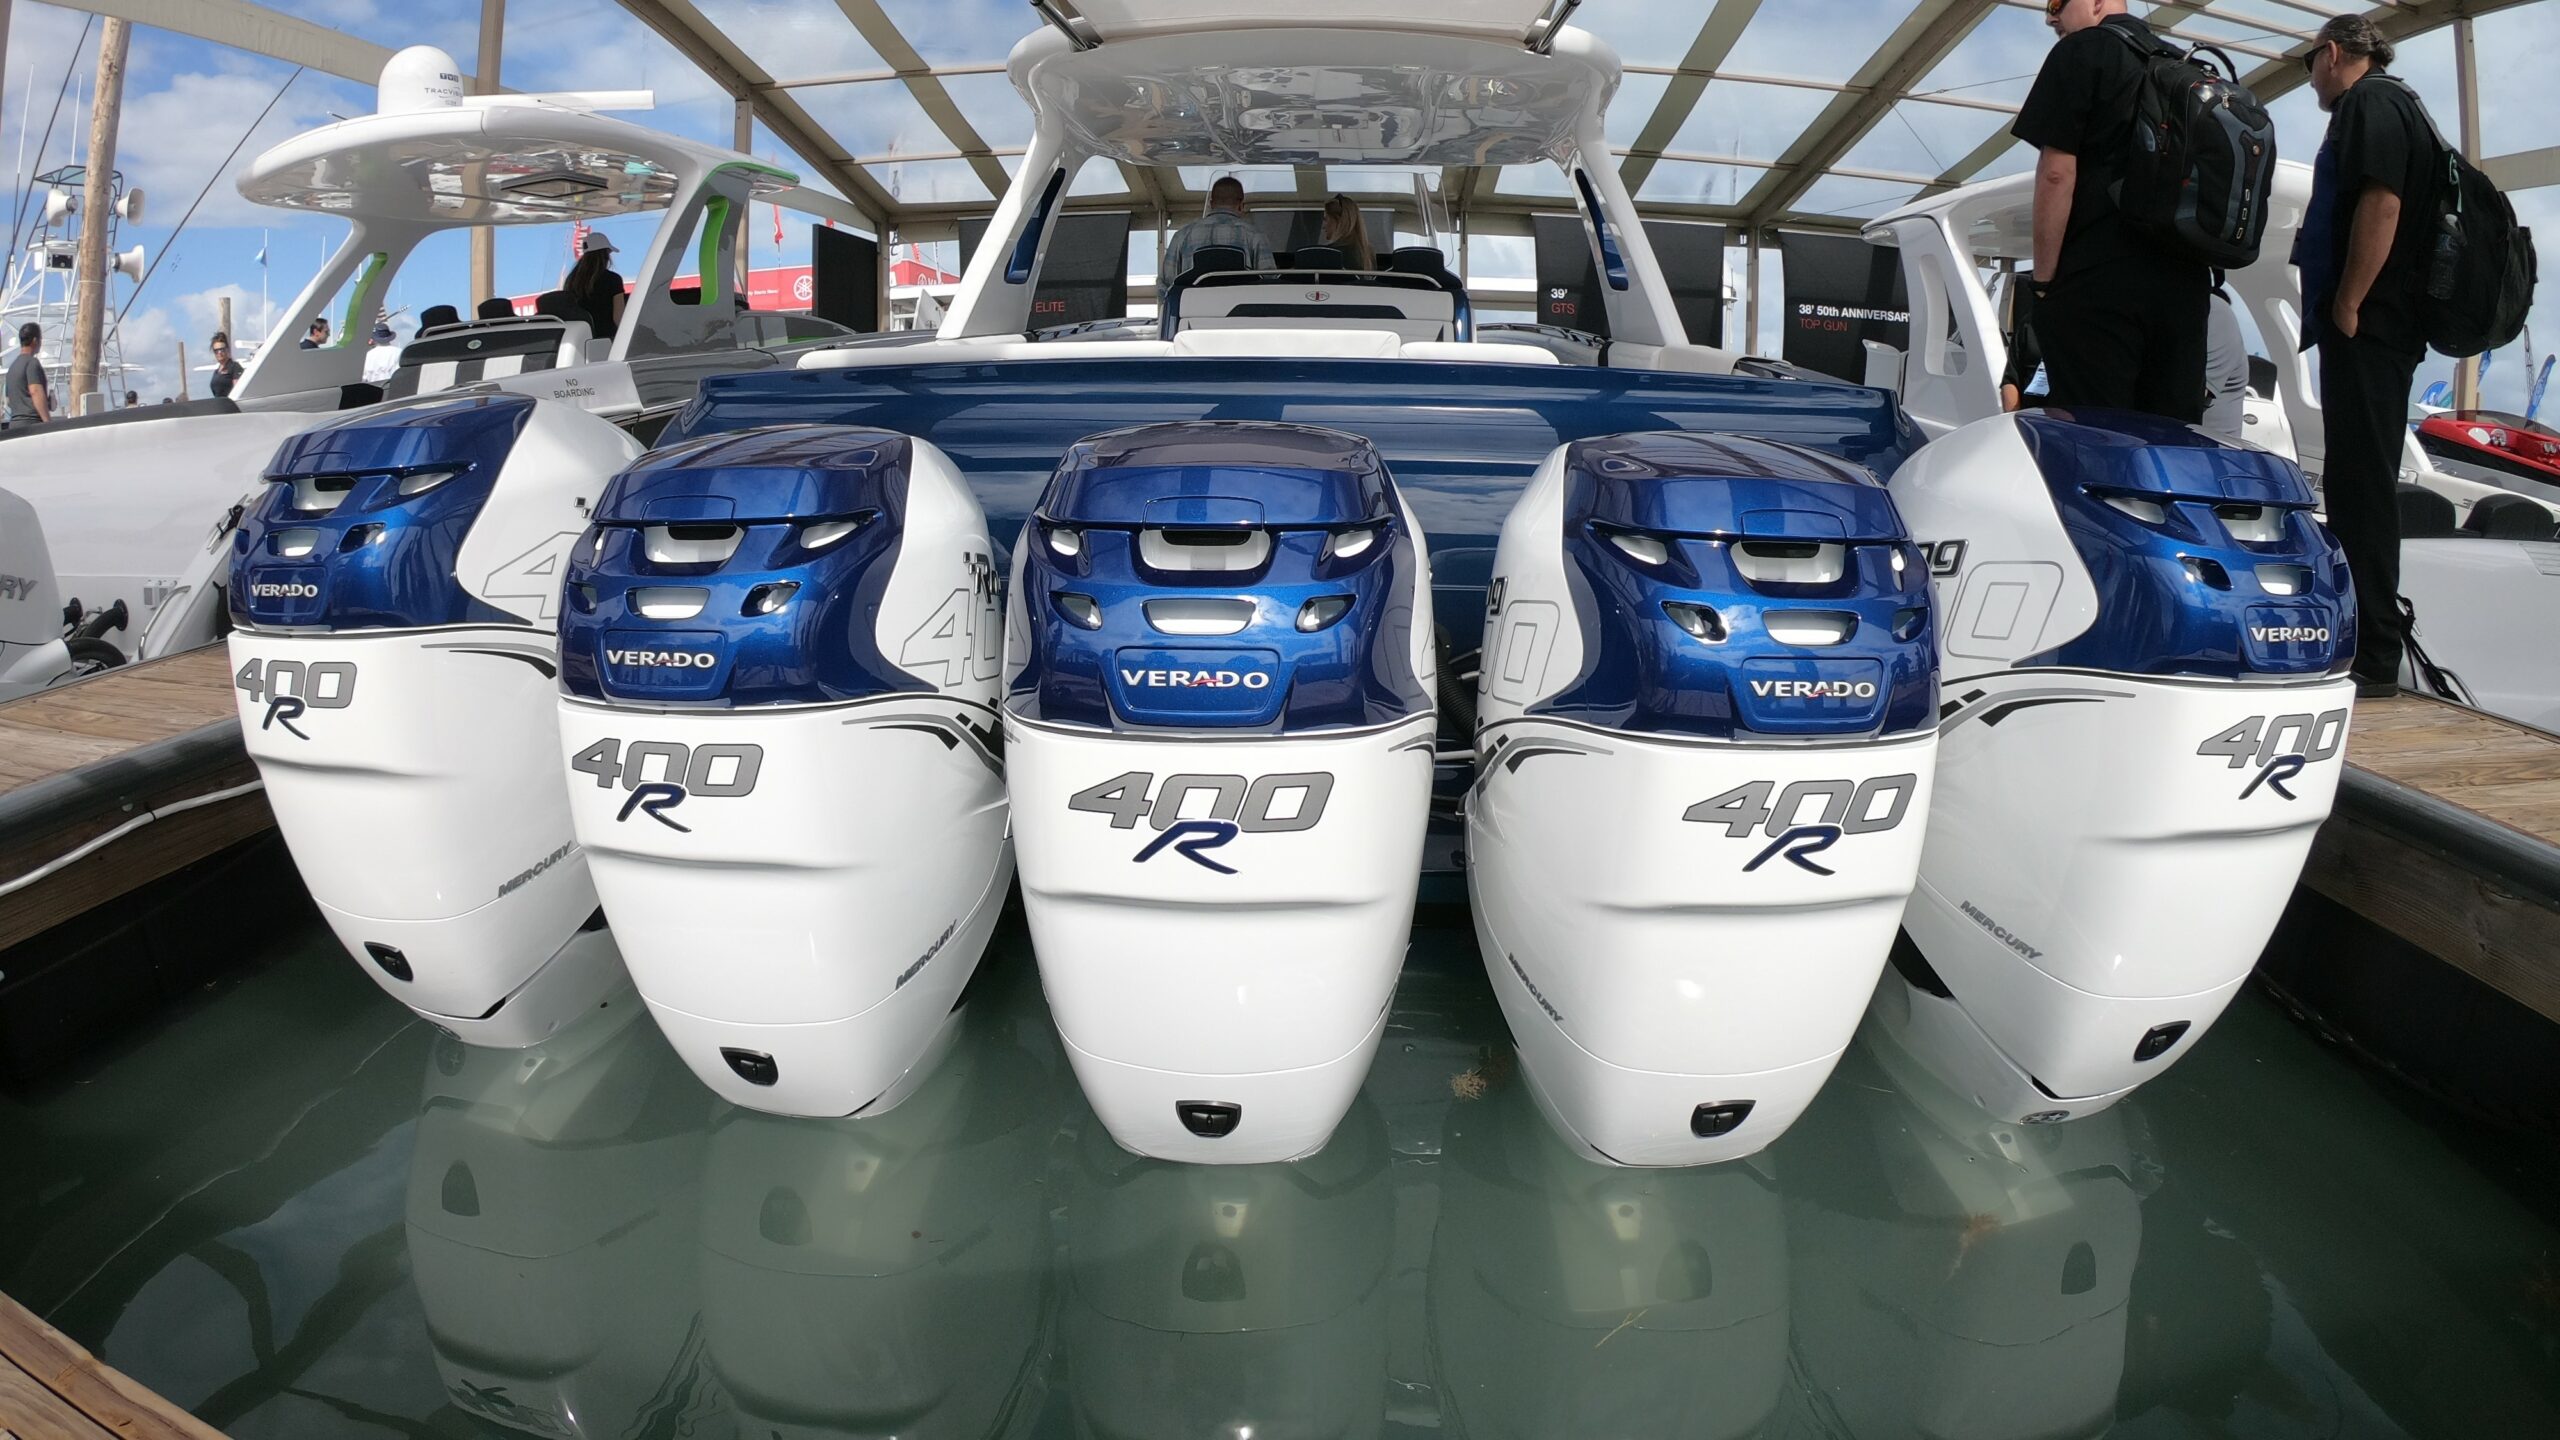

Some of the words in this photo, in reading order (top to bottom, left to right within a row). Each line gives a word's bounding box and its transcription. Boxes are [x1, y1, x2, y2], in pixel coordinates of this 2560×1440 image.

[1035, 302, 1065, 313] ELITE
[1551, 288, 1568, 299] 39'
[1552, 302, 1575, 315] GTS
[1799, 304, 1814, 315] 38'
[1817, 305, 1839, 317] 50th
[1841, 307, 1910, 323] ANNIVERSAR
[1801, 318, 1820, 329] TOP
[1823, 320, 1848, 332] GUN
[553, 387, 595, 399] BOARDING
[565, 378, 578, 387] NO
[252, 583, 318, 598] VERADO
[2251, 627, 2329, 642] VERADO
[606, 649, 715, 668] VERADO
[1121, 669, 1270, 689] VERADO
[236, 658, 357, 709] 400
[1750, 680, 1876, 698] VERADO
[262, 696, 310, 741] R
[2197, 707, 2347, 769] 400
[571, 737, 764, 798] 400
[2238, 754, 2306, 801] R
[616, 783, 692, 833] R
[1068, 771, 1335, 833] 400
[1682, 773, 1917, 838] 400
[498, 840, 571, 898] MERCURY
[1132, 820, 1239, 875] R
[1742, 825, 1842, 876] R
[1960, 900, 2043, 959] MERCURY
[895, 919, 957, 990] MERCURY
[1508, 952, 1564, 1022] MERCURY
